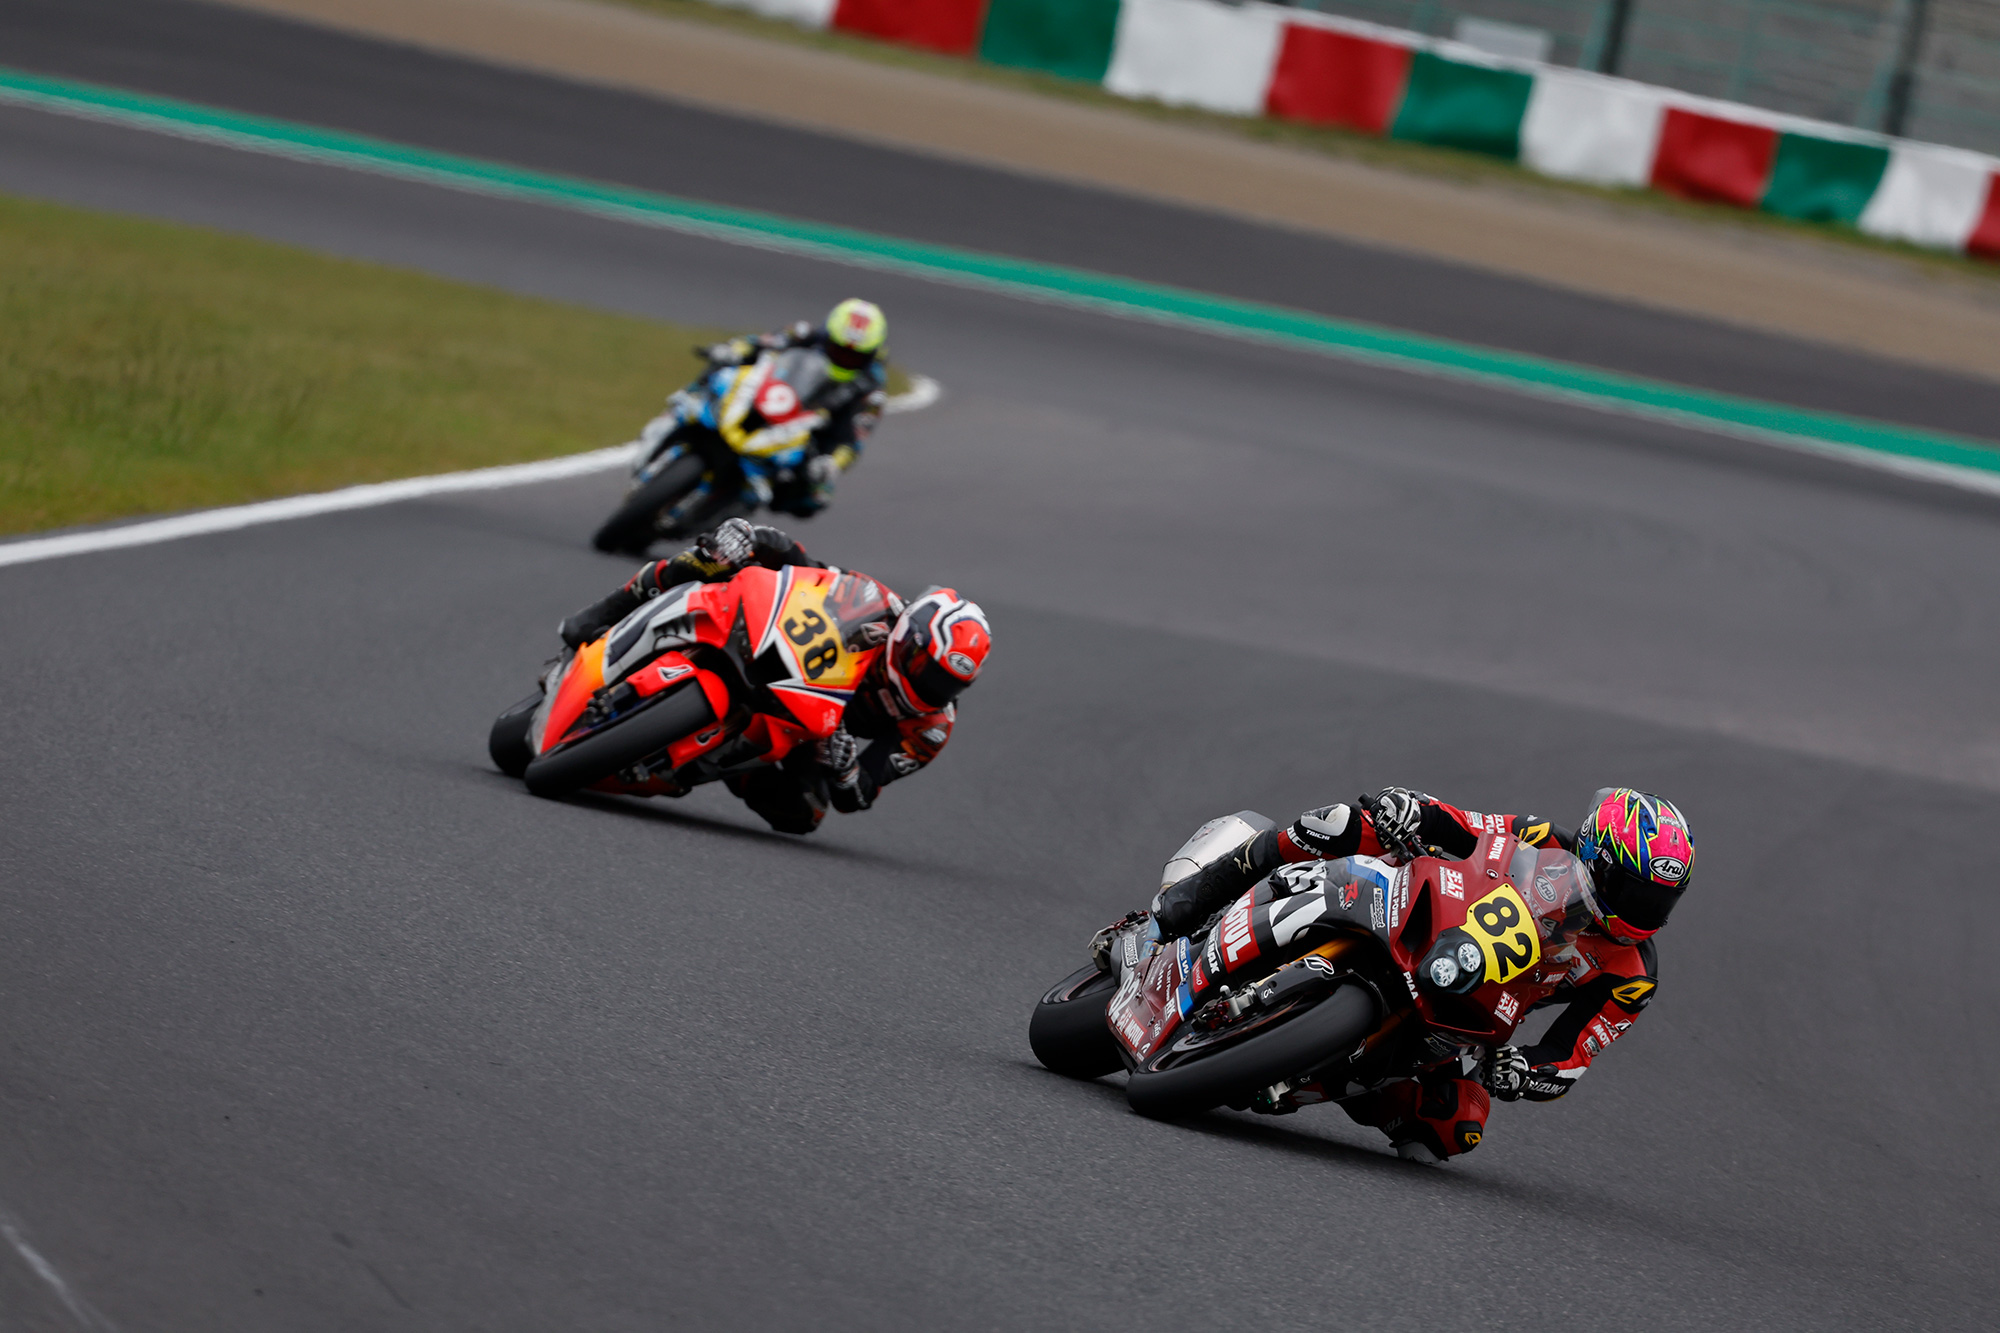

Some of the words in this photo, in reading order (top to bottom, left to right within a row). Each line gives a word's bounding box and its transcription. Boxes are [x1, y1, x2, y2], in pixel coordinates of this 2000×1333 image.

[783, 608, 840, 680] 38
[1305, 829, 1331, 841] TAICHI
[1488, 836, 1507, 860] MOTUL
[1653, 860, 1684, 877] Arai
[1400, 888, 1408, 909] MAX
[1537, 880, 1556, 900] Arai
[1391, 899, 1399, 928] POWER
[1223, 893, 1252, 963] MOTUL
[1473, 896, 1533, 978] 82
[1206, 945, 1220, 974] MAX
[1403, 971, 1419, 1000] PIAA
[1165, 998, 1177, 1021] RK
[1125, 1018, 1144, 1048] MOTUL
[1528, 1079, 1567, 1095] SUZUKI
